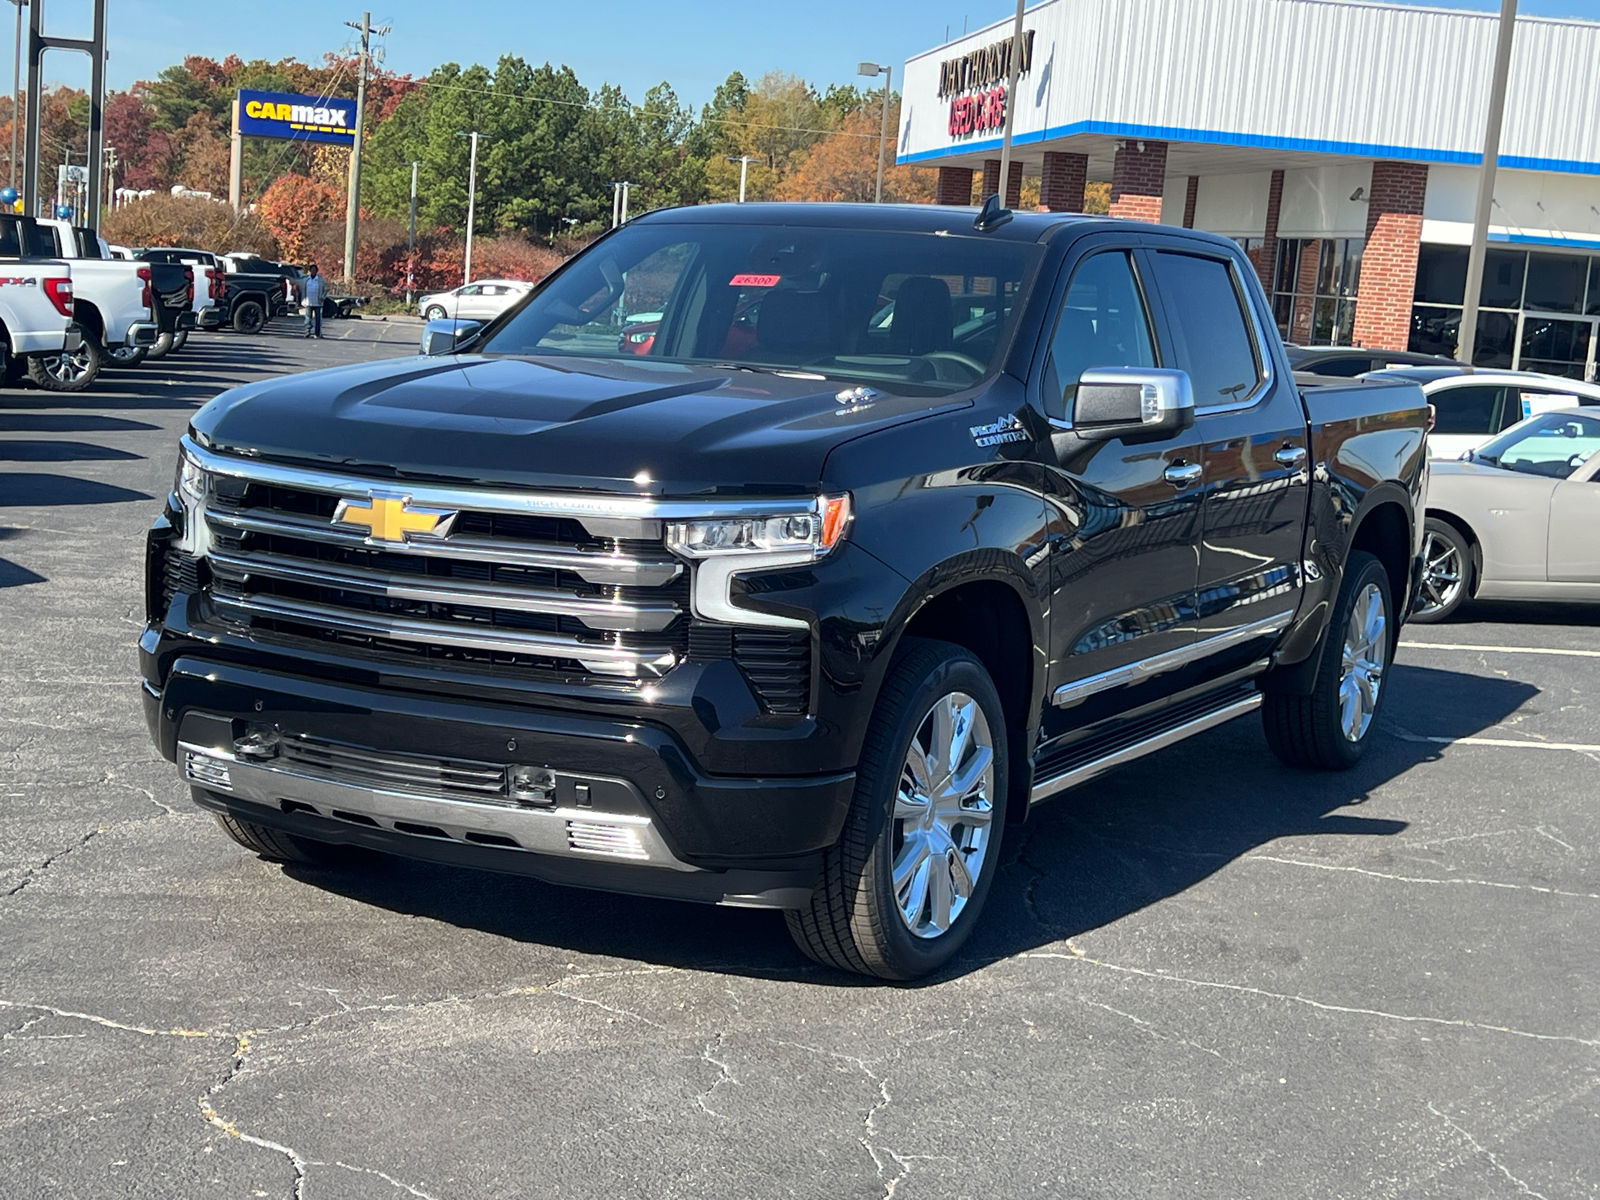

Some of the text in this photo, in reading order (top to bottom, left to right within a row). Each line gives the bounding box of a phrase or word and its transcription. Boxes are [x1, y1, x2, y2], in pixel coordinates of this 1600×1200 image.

[966, 29, 1035, 88] THORNTN
[948, 86, 1006, 136] USED CARS
[736, 276, 772, 285] 26300
